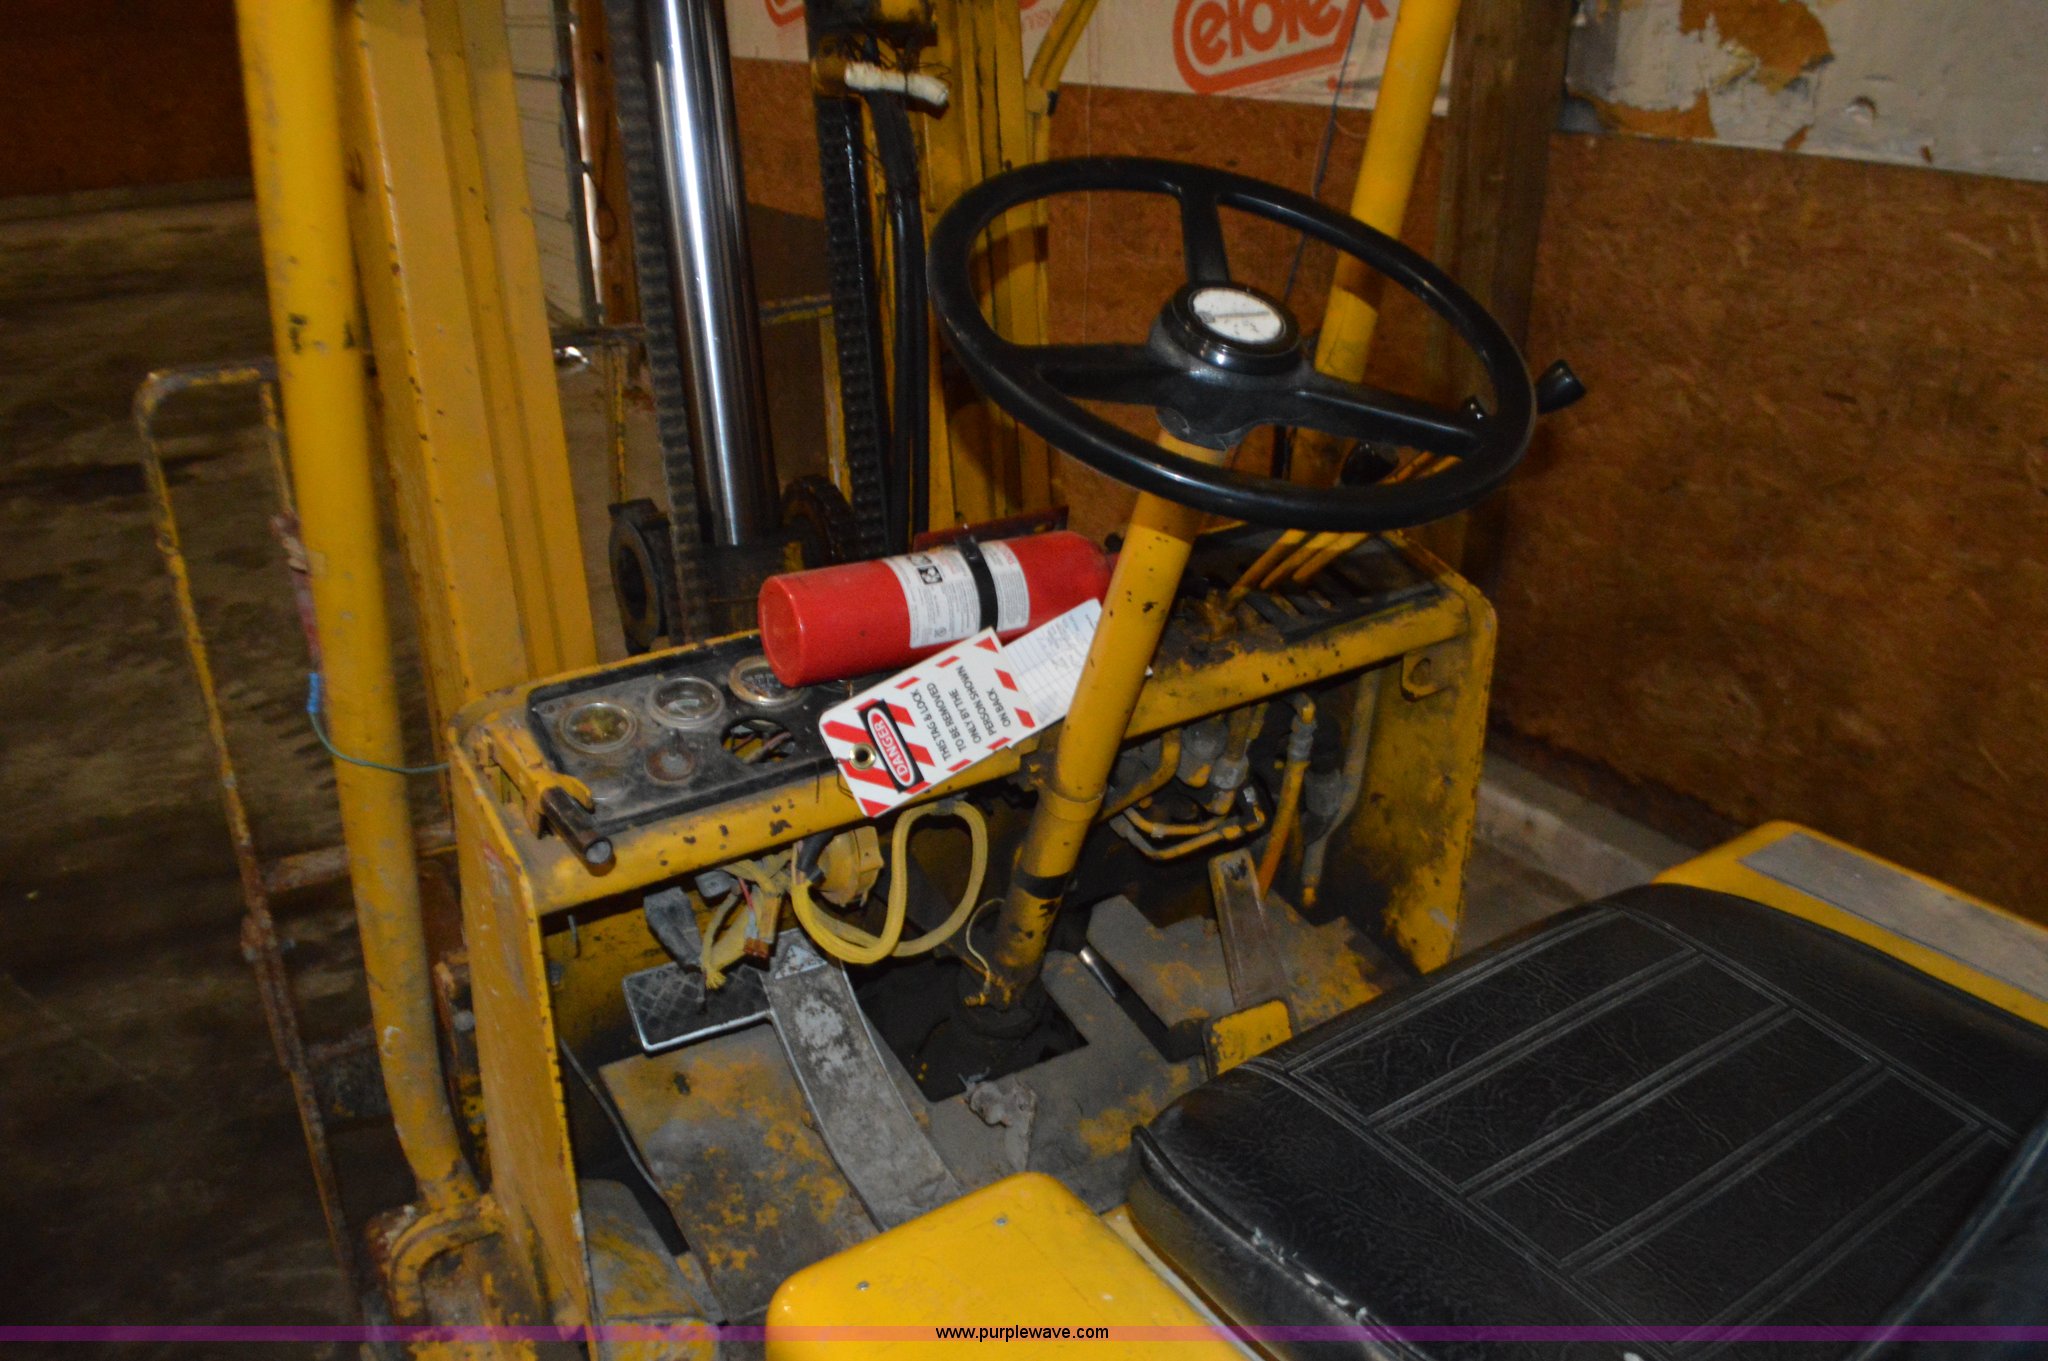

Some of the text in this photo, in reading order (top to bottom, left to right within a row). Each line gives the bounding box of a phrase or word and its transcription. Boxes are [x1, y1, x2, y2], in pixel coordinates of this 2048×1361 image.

[911, 689, 952, 761] THIS TAG & LOCK
[926, 682, 967, 752] TO BE REMOVED
[948, 688, 981, 744] ONLY BY THE
[957, 665, 997, 736] PERSON SHOWN
[986, 688, 1011, 728] ON BACK
[874, 720, 908, 777] DANGER
